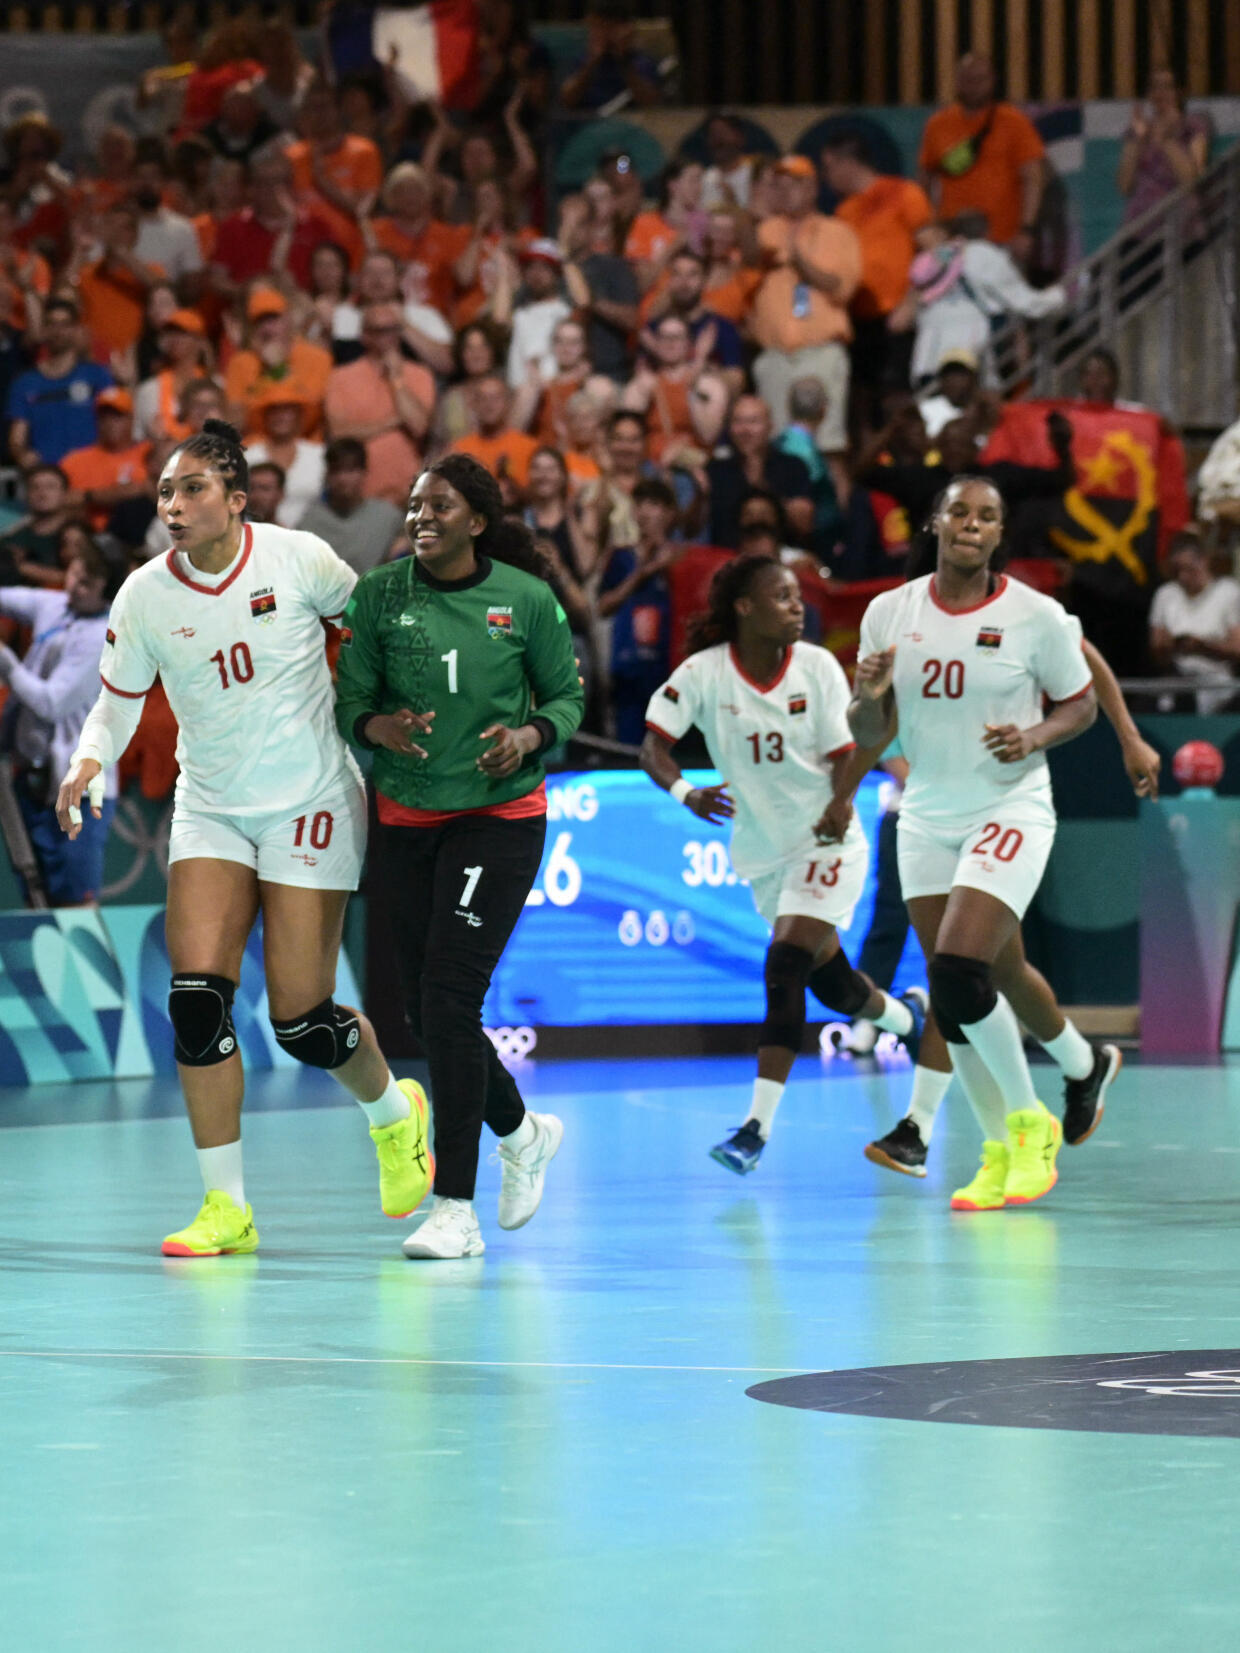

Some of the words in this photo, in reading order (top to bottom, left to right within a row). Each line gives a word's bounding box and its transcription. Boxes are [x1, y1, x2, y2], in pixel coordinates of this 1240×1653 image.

[209, 641, 255, 690] 10
[441, 649, 458, 694] 1
[922, 658, 965, 700] 20
[745, 731, 784, 764] 13
[546, 784, 600, 822] NG
[290, 810, 334, 850] 10
[971, 822, 1024, 863] 20
[459, 865, 484, 908] 1
[805, 857, 843, 887] 13
